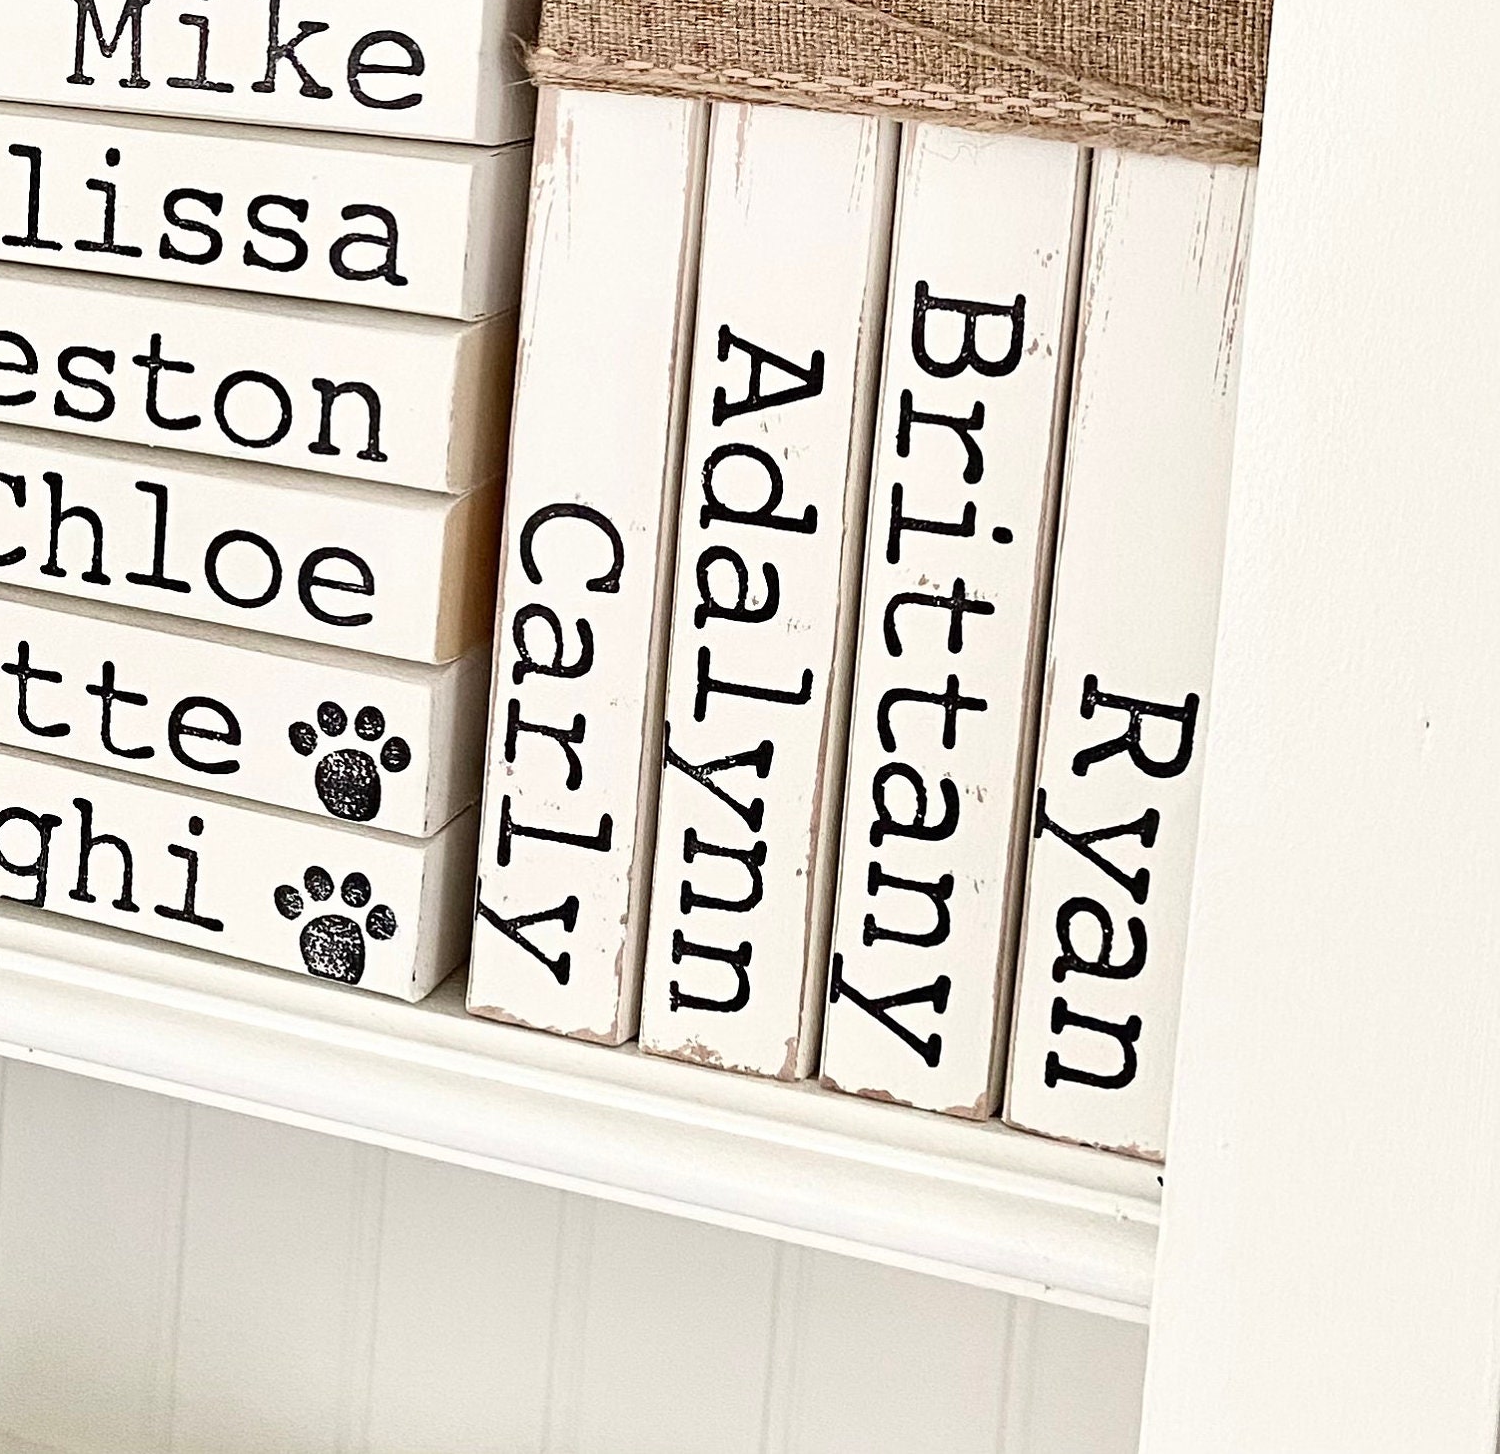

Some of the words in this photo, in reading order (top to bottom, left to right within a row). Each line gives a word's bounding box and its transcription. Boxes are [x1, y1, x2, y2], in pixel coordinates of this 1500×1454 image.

[474, 502, 626, 987] Carly
[663, 323, 826, 1014] Adalynn
[829, 279, 1028, 1069] Brittany
[1032, 672, 1201, 1091] Ryan
